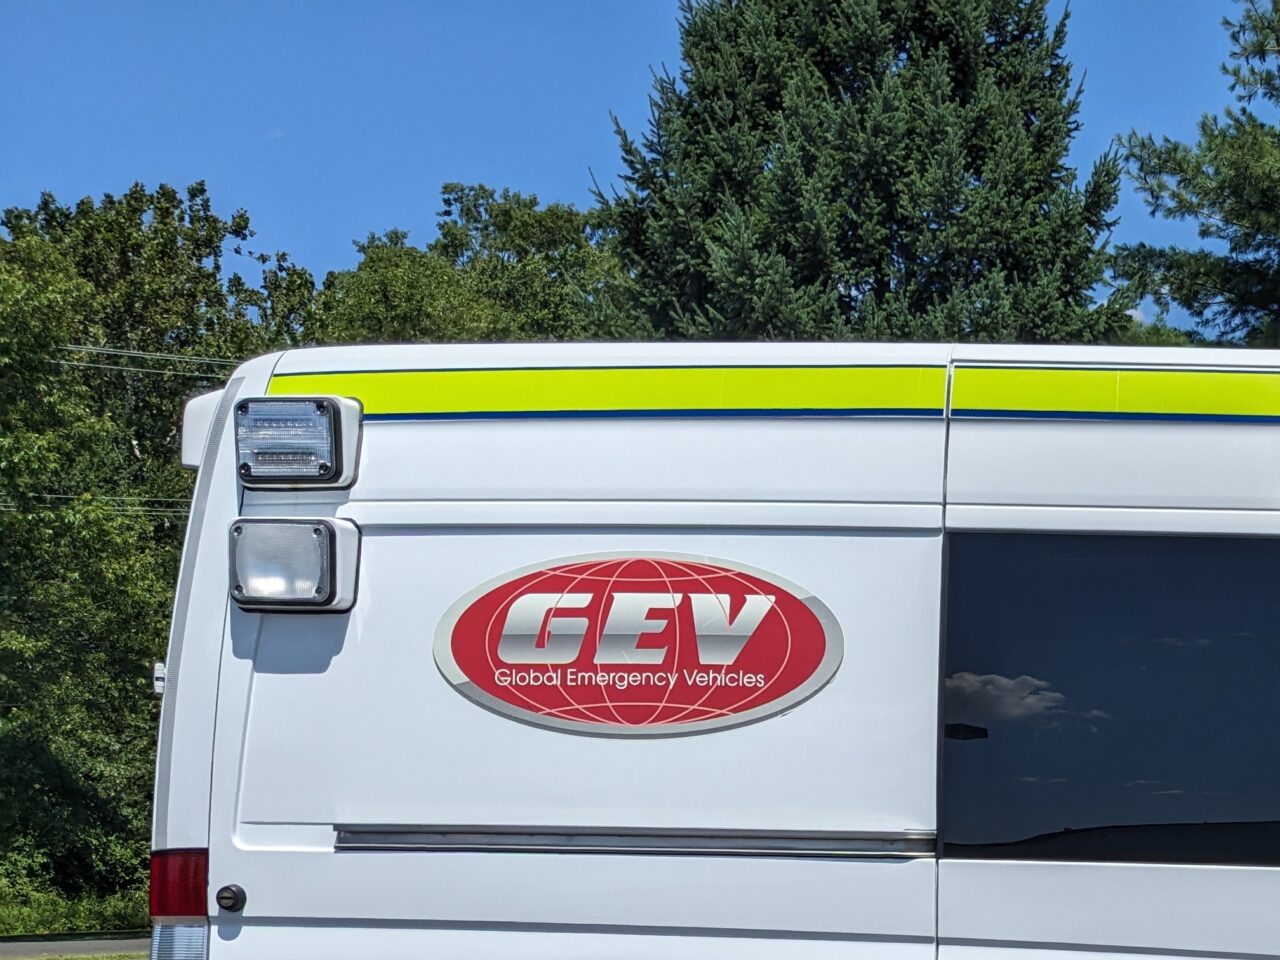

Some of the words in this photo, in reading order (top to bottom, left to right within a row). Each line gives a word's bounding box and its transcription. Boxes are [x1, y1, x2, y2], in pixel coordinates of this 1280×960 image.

[497, 592, 776, 666] GEV
[494, 668, 561, 687] Global
[566, 669, 678, 690] Emergency
[682, 669, 765, 688] Vehicles
